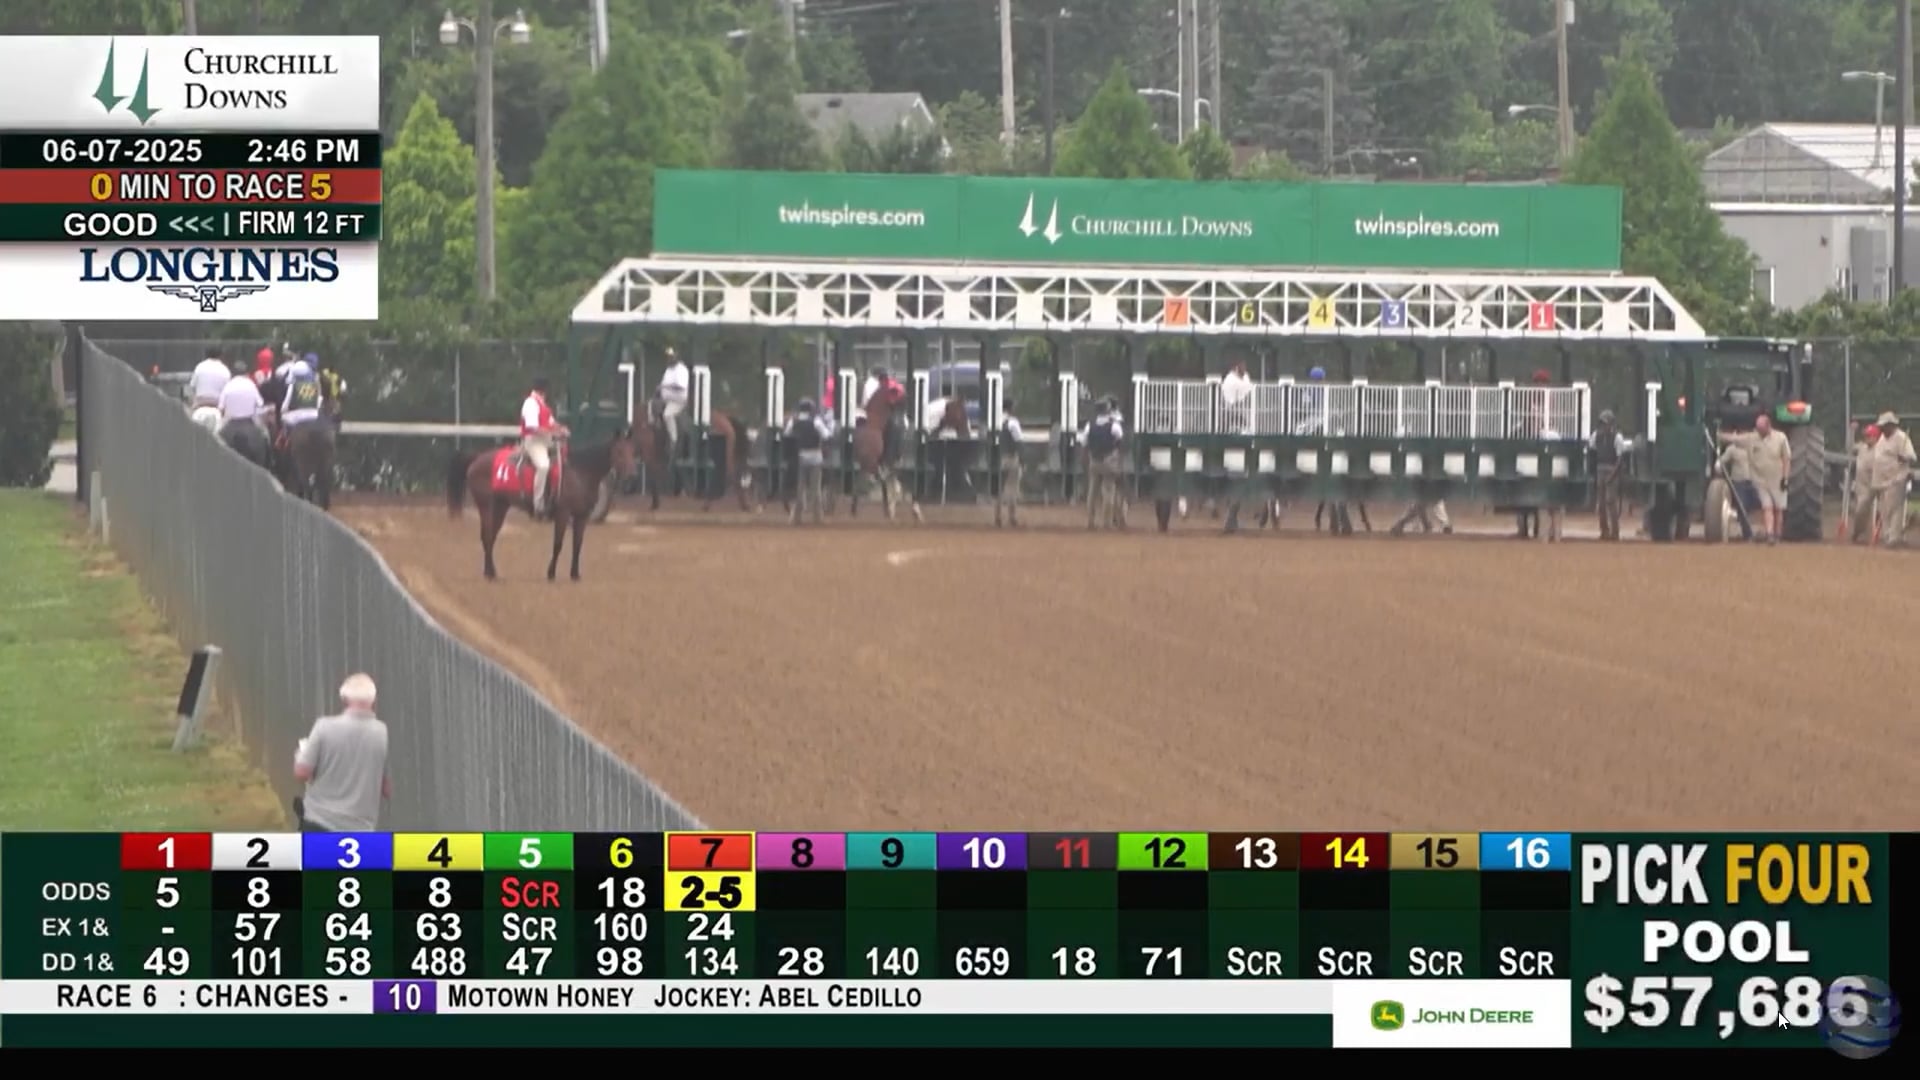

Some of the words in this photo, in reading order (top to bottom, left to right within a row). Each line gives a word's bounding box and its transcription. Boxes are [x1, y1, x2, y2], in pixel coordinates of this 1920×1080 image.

[779, 203, 924, 227] twinspires.com
[1072, 216, 1176, 235] CHURCHILL
[1182, 216, 1252, 236] DOWNS
[1355, 213, 1499, 238] twinspires.com
[1170, 301, 1183, 322] 7
[1242, 302, 1254, 322] 6
[1314, 302, 1328, 323] 4
[1387, 303, 1399, 325] 3
[1461, 306, 1473, 325] 2
[1537, 307, 1548, 327] 1
